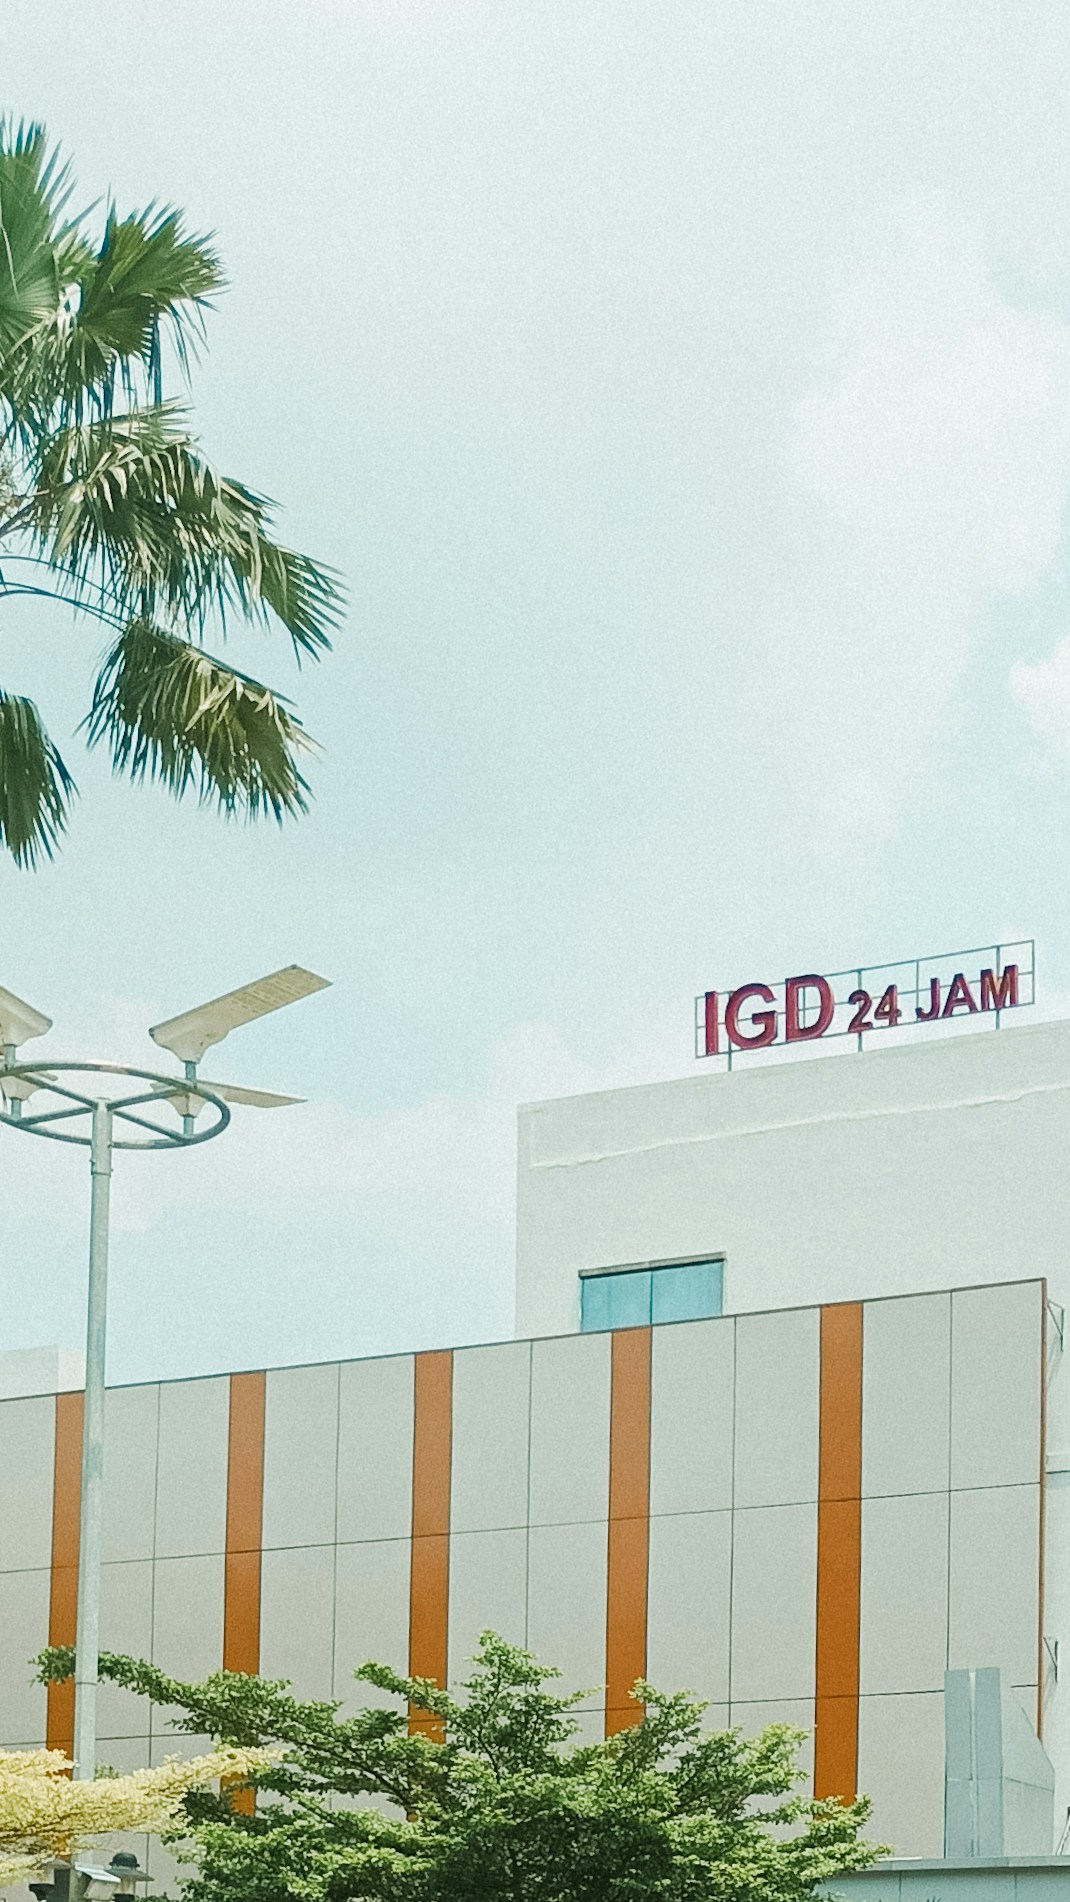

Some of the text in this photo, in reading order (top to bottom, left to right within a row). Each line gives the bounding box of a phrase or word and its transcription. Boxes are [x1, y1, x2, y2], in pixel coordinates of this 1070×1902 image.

[705, 964, 1018, 1055] IGD 24 JAM
